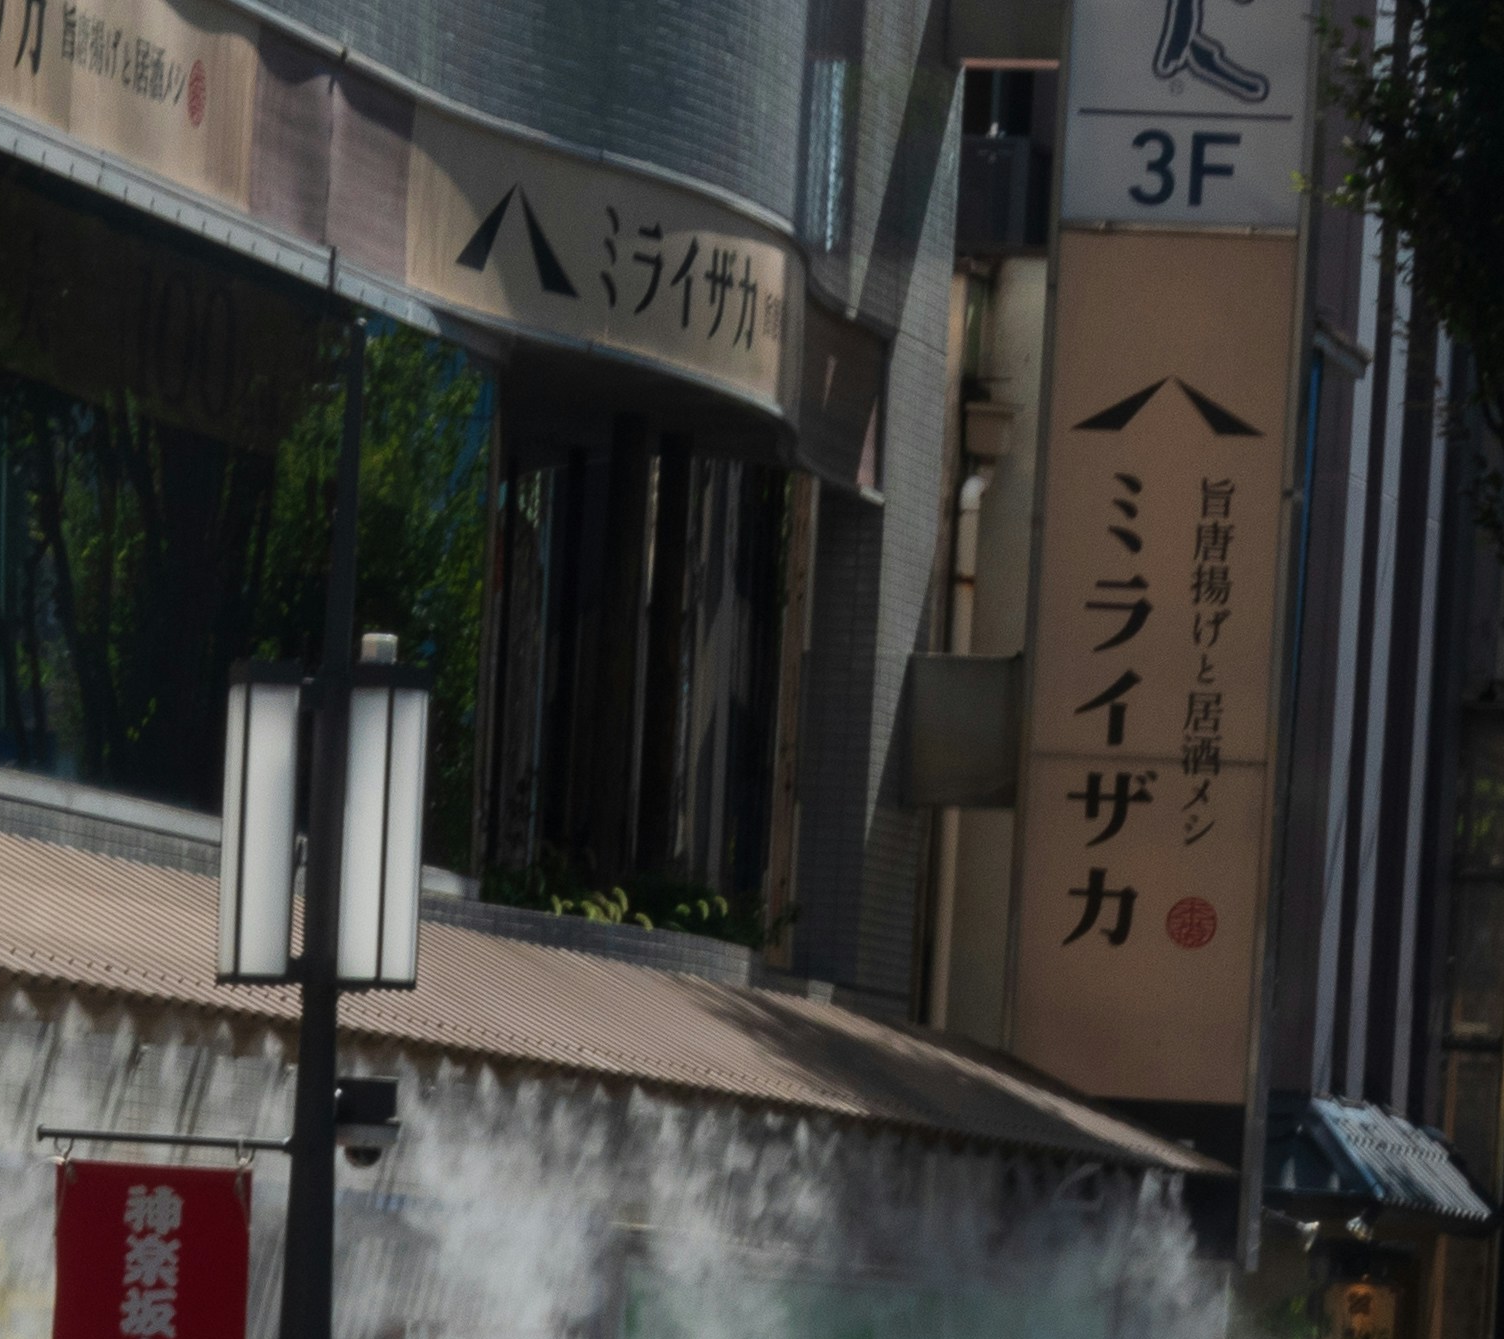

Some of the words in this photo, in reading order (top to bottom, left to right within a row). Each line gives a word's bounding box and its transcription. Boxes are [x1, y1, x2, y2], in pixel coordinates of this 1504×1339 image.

[600, 204, 758, 351] ミライザカ
[1128, 128, 1242, 208] 3F
[1059, 470, 1159, 948] ミライザカ
[1179, 476, 1237, 848] 旨唐揚げと居酒メシ
